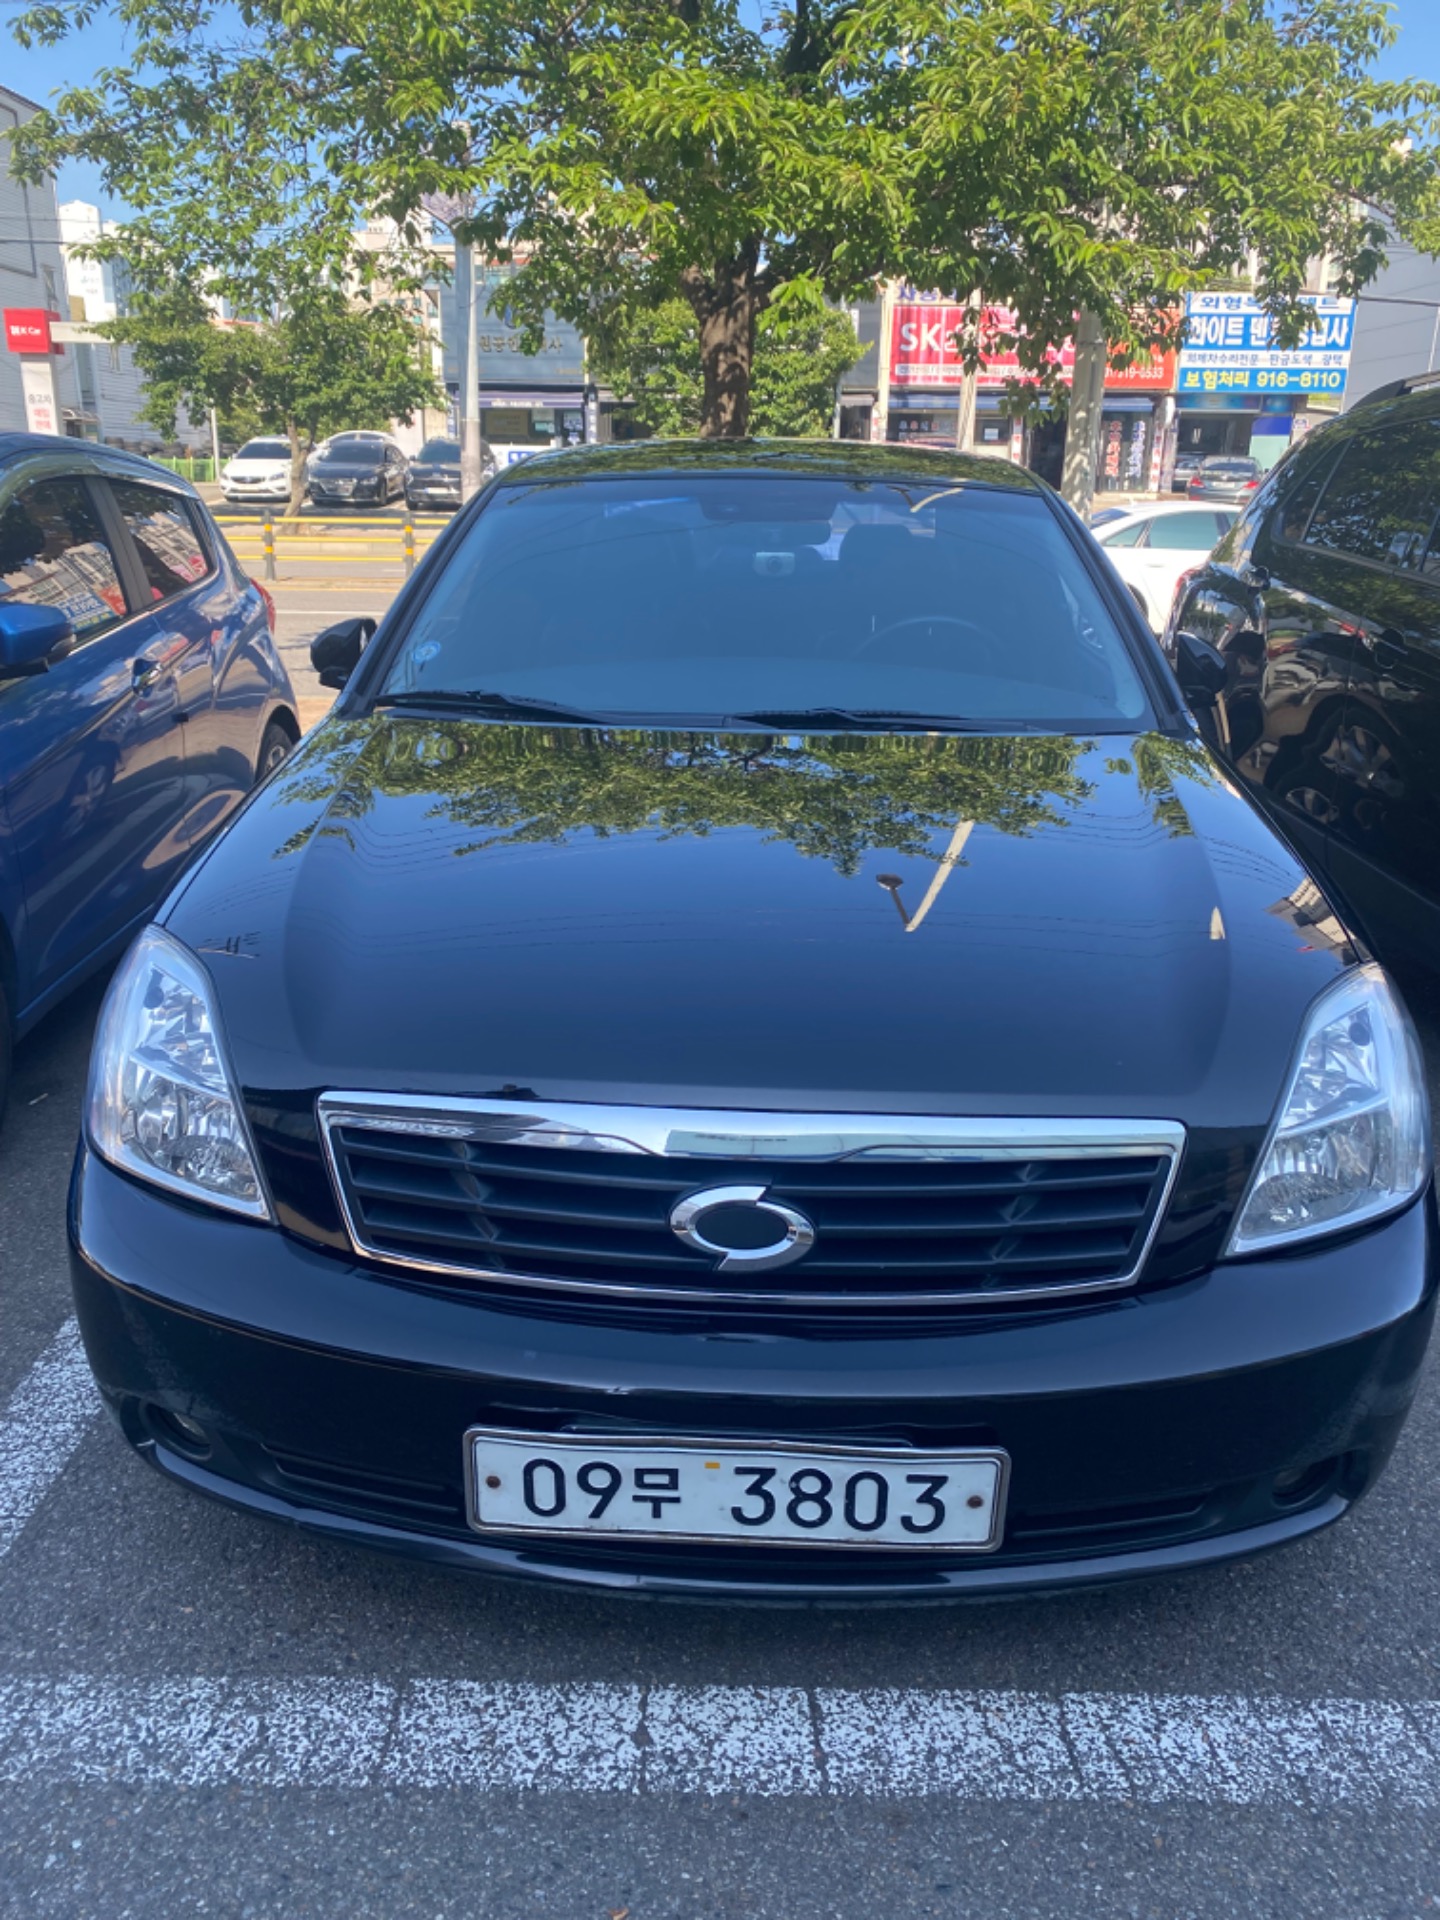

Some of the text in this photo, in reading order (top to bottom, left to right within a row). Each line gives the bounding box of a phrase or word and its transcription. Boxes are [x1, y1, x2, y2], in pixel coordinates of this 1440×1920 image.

[1188, 315, 1244, 346] 화이트
[1184, 371, 1340, 390] 보험처리 916-8110
[522, 1457, 950, 1534] 09무 3803
